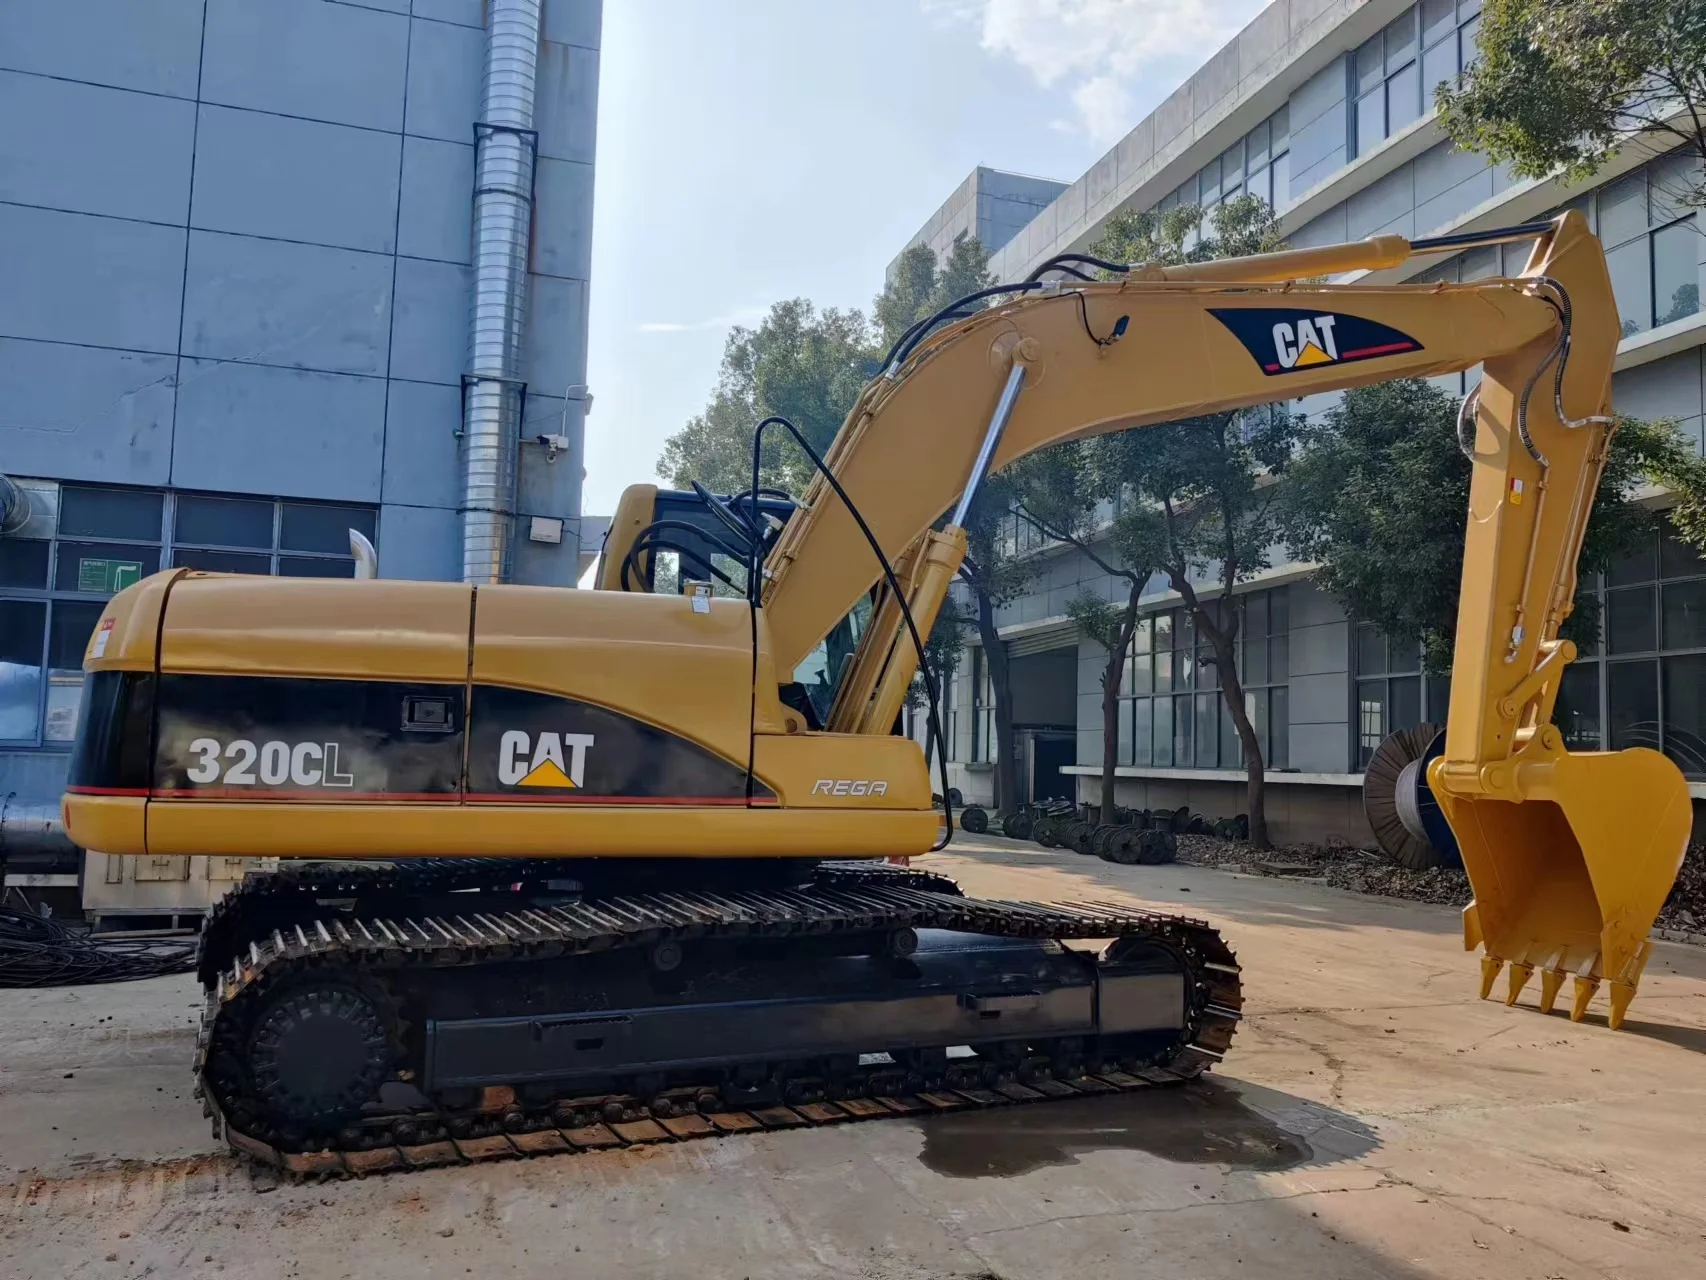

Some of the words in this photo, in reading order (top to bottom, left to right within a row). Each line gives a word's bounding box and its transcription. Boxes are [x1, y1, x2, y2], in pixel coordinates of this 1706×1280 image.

[1272, 314, 1339, 368] CAT
[498, 730, 595, 788] CAT
[811, 779, 888, 797] REGA
